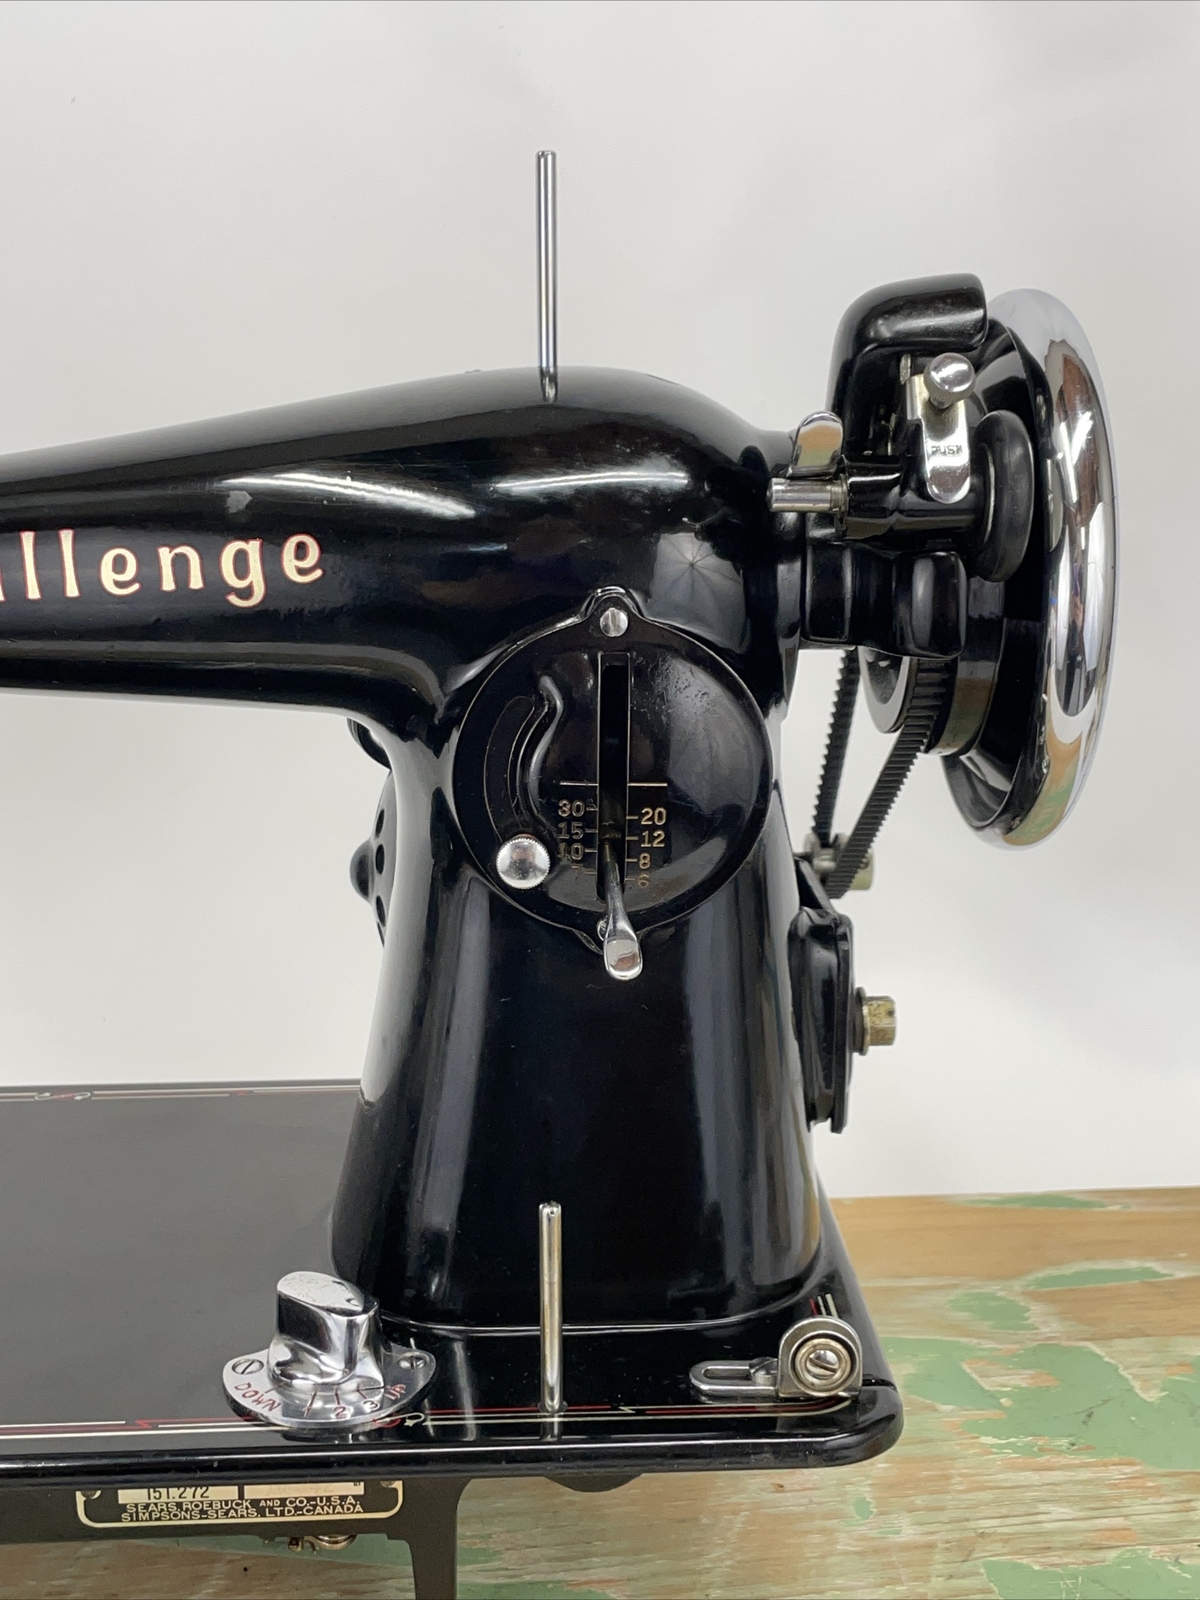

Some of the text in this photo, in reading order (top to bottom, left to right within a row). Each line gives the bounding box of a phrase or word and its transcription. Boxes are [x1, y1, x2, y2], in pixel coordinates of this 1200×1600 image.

[931, 445, 963, 456] PUSH
[0, 528, 324, 608] llenge
[558, 800, 585, 817] 30
[640, 807, 667, 826] 20
[557, 821, 583, 839] 15
[640, 830, 665, 848] 12
[557, 842, 584, 861] 10
[639, 852, 651, 870] 8
[234, 1381, 282, 1412] DOWN
[384, 1383, 407, 1401] UP
[333, 1405, 347, 1419] 2
[362, 1399, 379, 1410] 3
[182, 1500, 252, 1512] ROEBUCK
